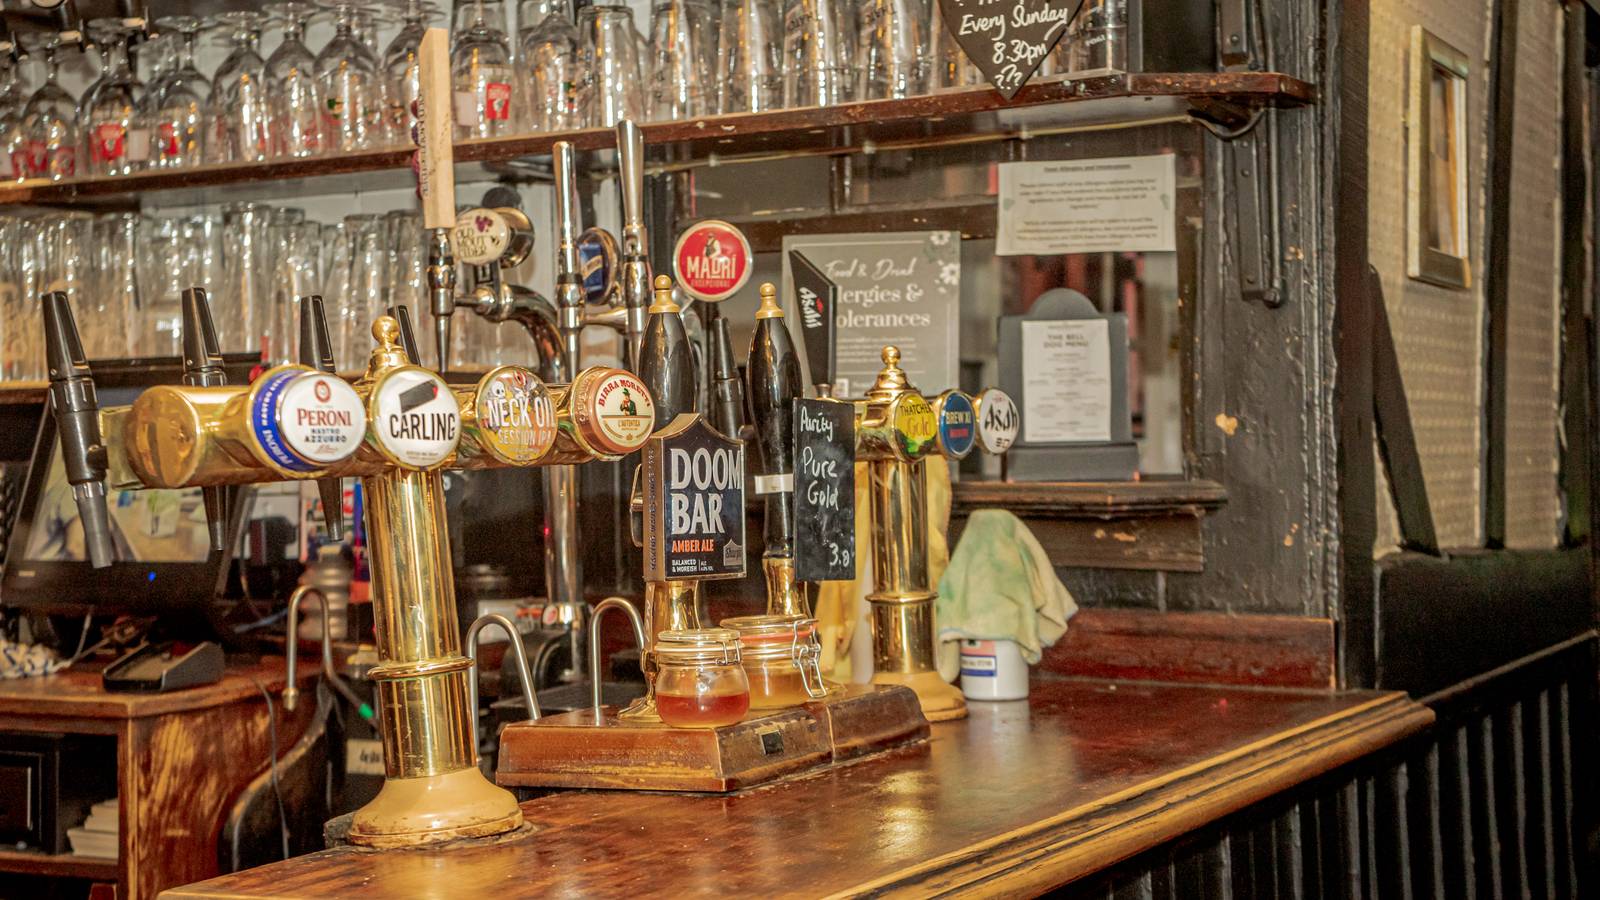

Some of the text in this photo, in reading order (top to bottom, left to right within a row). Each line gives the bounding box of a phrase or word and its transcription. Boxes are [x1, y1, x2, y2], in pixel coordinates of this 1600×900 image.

[959, 3, 1068, 41] Every Sunday
[992, 39, 1048, 65] 8.30pm
[686, 254, 737, 279] MADRÍ
[824, 258, 859, 277] Food
[837, 283, 925, 308] lergies &
[837, 310, 931, 328] olerances
[598, 380, 620, 407] BIRRA
[296, 407, 353, 427] PERONI
[487, 397, 533, 428] NECK
[534, 396, 557, 428] OIL
[389, 412, 456, 442] CARLING
[497, 429, 552, 447] SESSION IPA
[670, 447, 742, 491] DOOM
[802, 446, 838, 479] Pure
[807, 480, 839, 512] Gold
[670, 493, 726, 535] BAR
[671, 538, 715, 553] AMBER ALE
[677, 565, 698, 573] MOREISH
